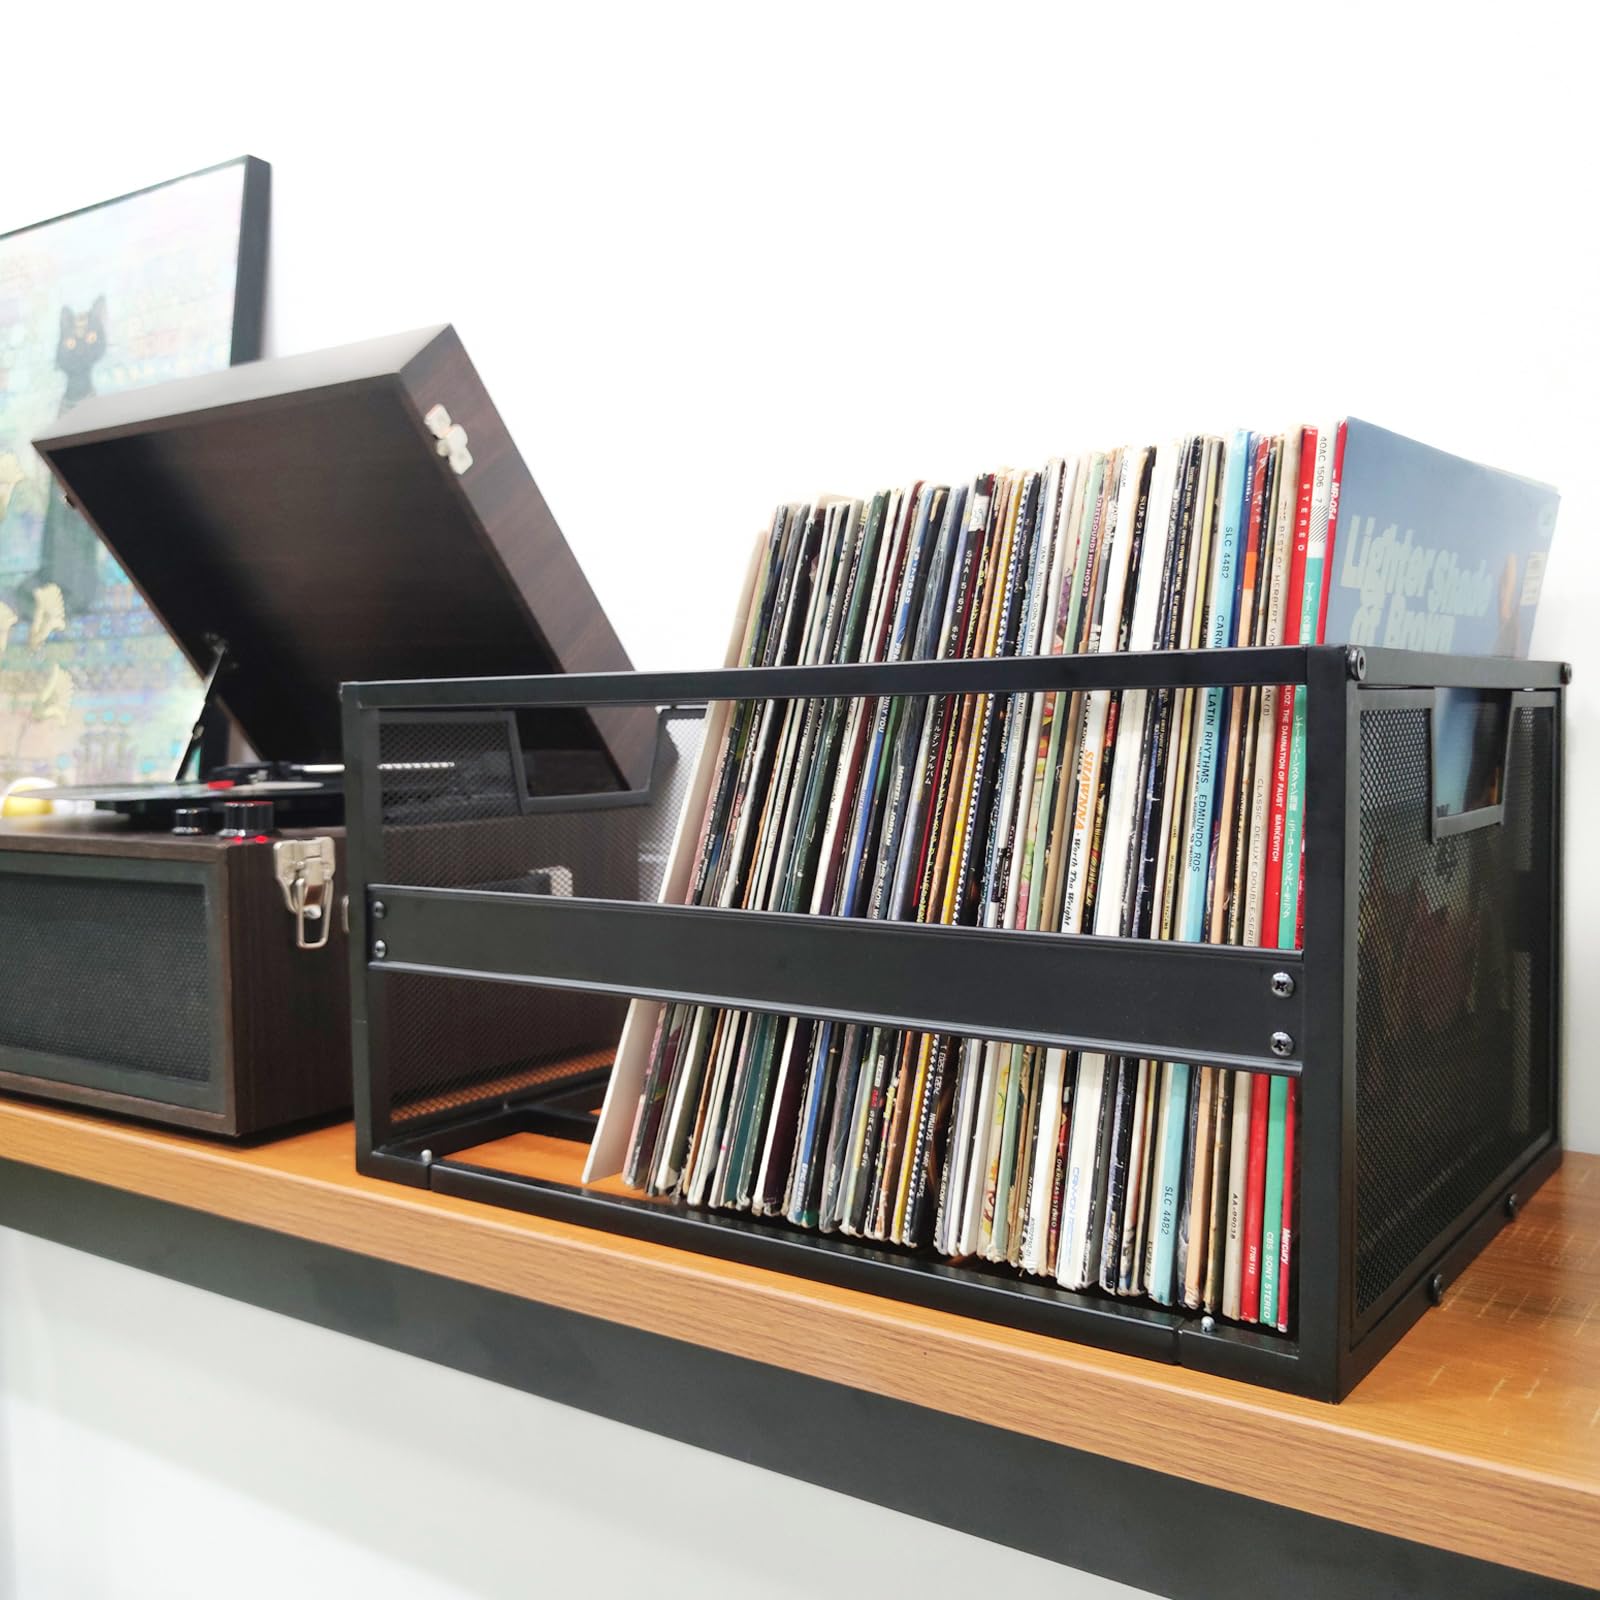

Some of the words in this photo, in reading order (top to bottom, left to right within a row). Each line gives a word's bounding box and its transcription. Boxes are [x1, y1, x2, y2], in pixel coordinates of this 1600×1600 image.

[1316, 466, 1325, 488] 1506
[1298, 483, 1310, 551] STEREO
[1328, 482, 1340, 520] MR-054
[1224, 527, 1232, 547] SLC
[1222, 552, 1230, 579] 4482
[1270, 574, 1280, 622] HERBERT
[878, 716, 888, 733] YOU
[1206, 694, 1216, 726] LATIN
[1200, 731, 1214, 784] RHYTHMS
[1278, 726, 1288, 769] DAMNATION
[890, 766, 904, 806] MONTELL
[1074, 750, 1094, 831] SHAWNNA
[1254, 778, 1263, 820] CLASSIC
[1276, 783, 1284, 807] FAUST
[884, 808, 896, 846] JORDAN
[1194, 794, 1208, 848] EDMUNDO
[1272, 814, 1282, 862] MARKEVITCH
[1070, 838, 1082, 868] Worth
[1192, 852, 1202, 872] ROS
[1252, 826, 1260, 868] DELUXE
[1063, 892, 1074, 926] Weight
[926, 1112, 936, 1141] SCATMAN
[1053, 1158, 1063, 1195] OVERSEAS
[1163, 1186, 1174, 1205] SLC
[1050, 1200, 1060, 1228] STEREO
[1160, 1210, 1172, 1236] 4482
[1265, 1232, 1274, 1250] CBS
[1280, 1228, 1292, 1264] Mercury
[1264, 1254, 1274, 1280] SONY
[1264, 1282, 1272, 1319] STEREO
